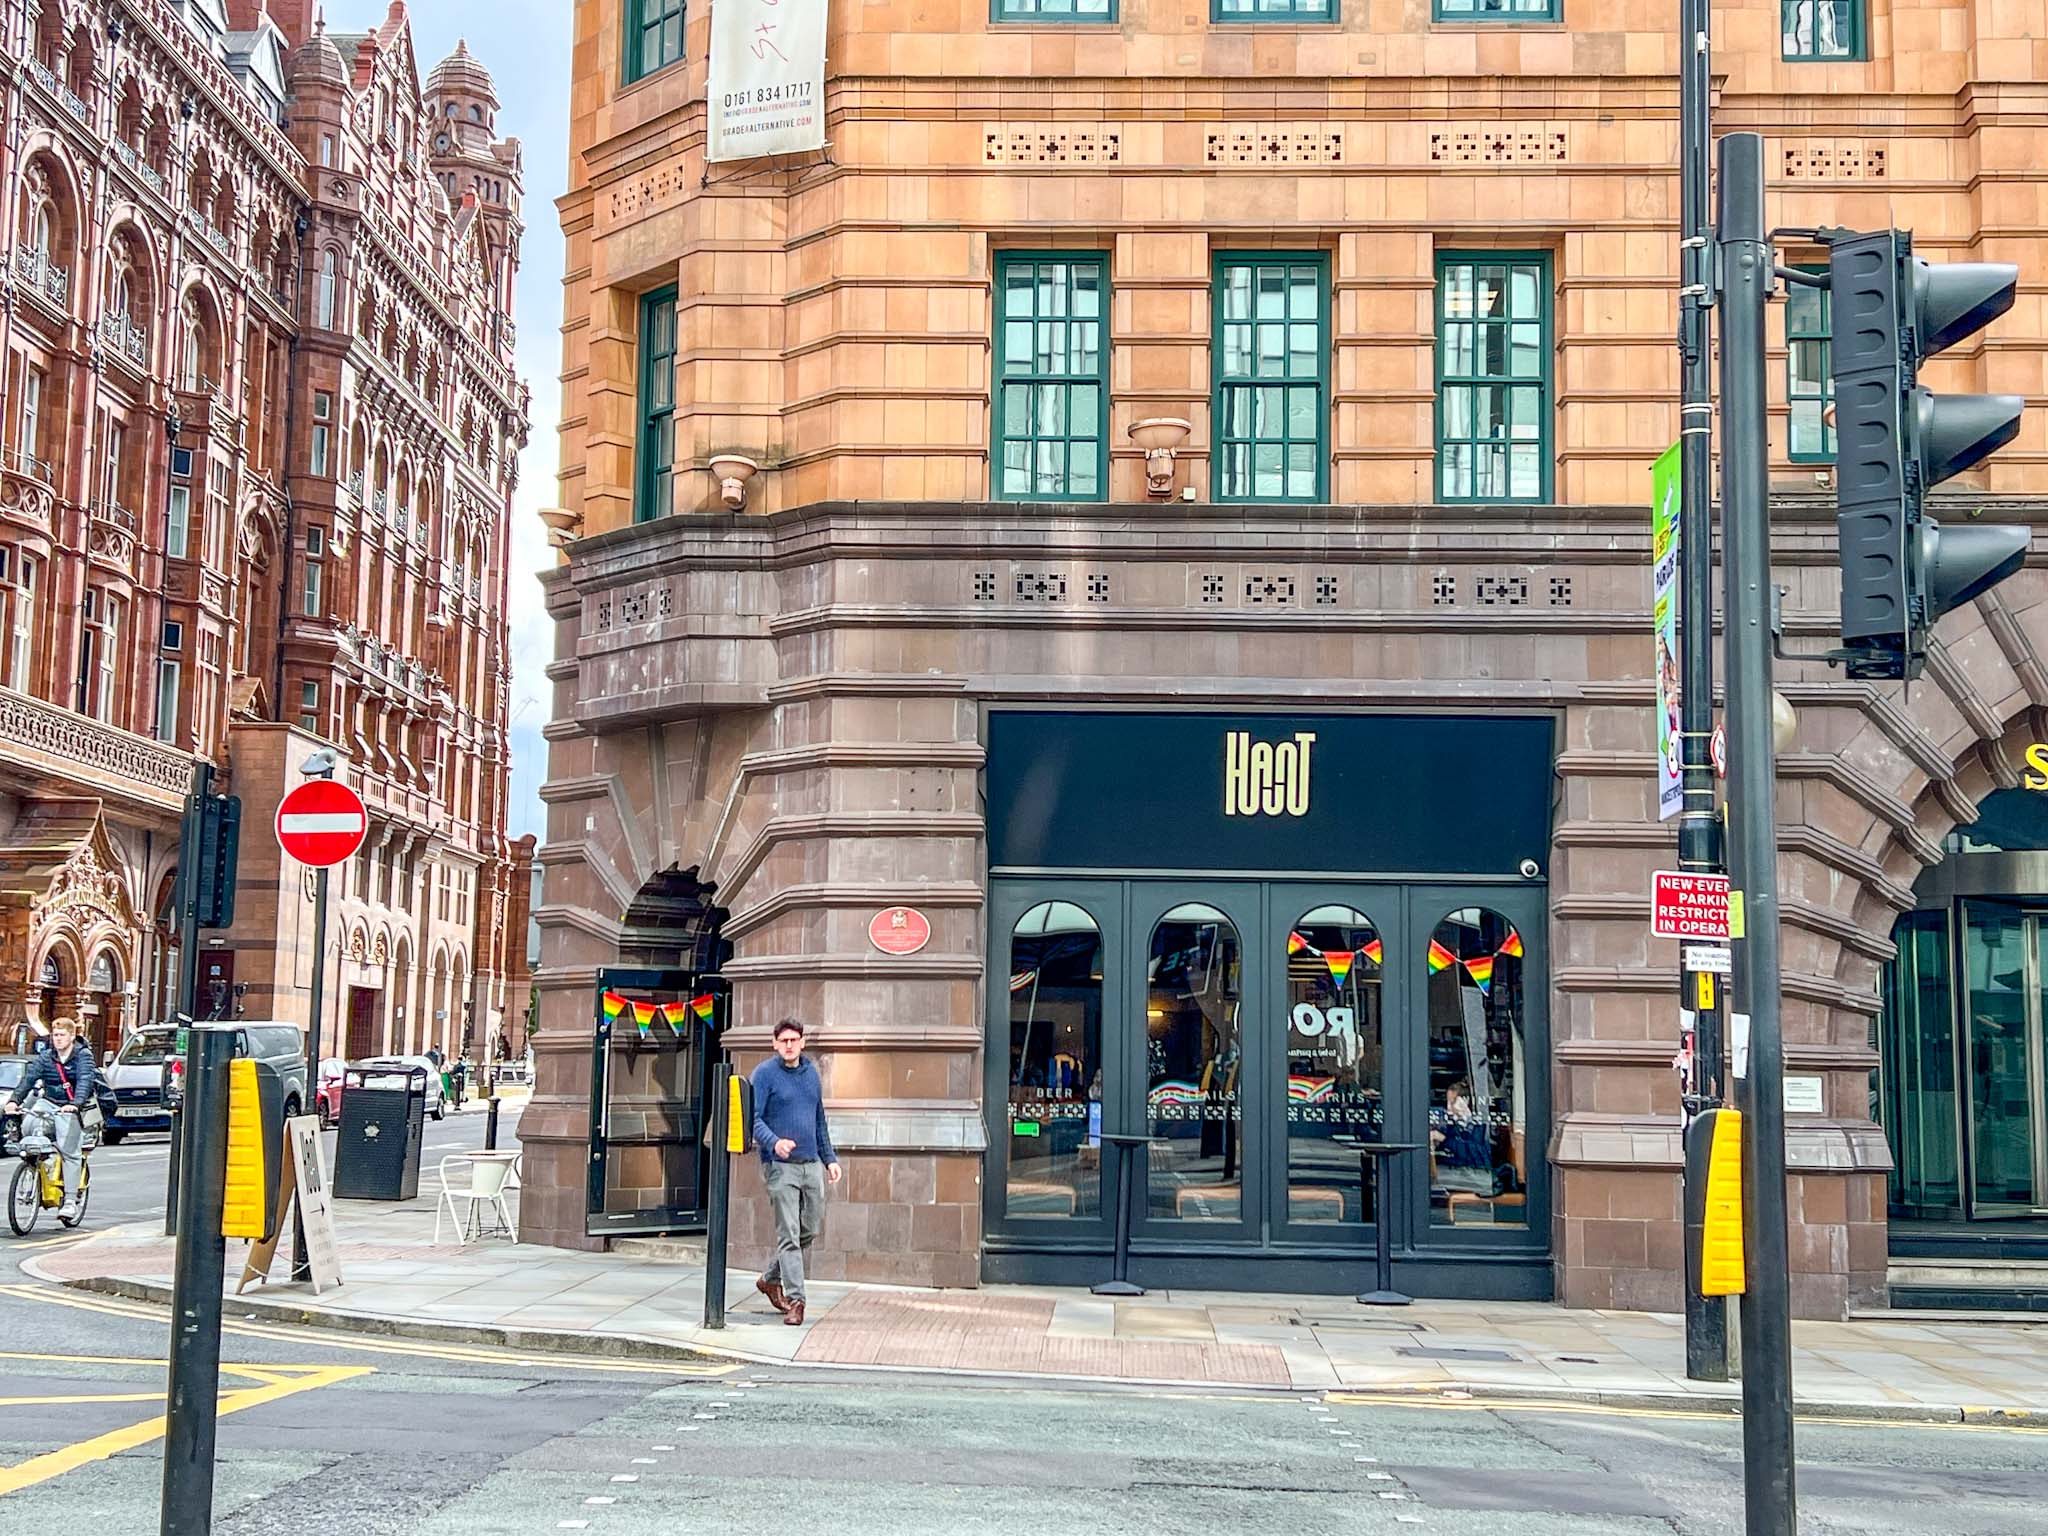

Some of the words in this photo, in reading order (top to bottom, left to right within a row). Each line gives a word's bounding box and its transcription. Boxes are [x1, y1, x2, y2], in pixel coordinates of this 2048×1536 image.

[724, 89, 751, 108] 0161
[757, 86, 780, 103] 834
[786, 81, 811, 99] 1717
[1660, 877, 1693, 891] NEW
[1659, 919, 1675, 931] IN
[1679, 920, 1730, 935] OPERA
[1036, 1088, 1073, 1099] BEER
